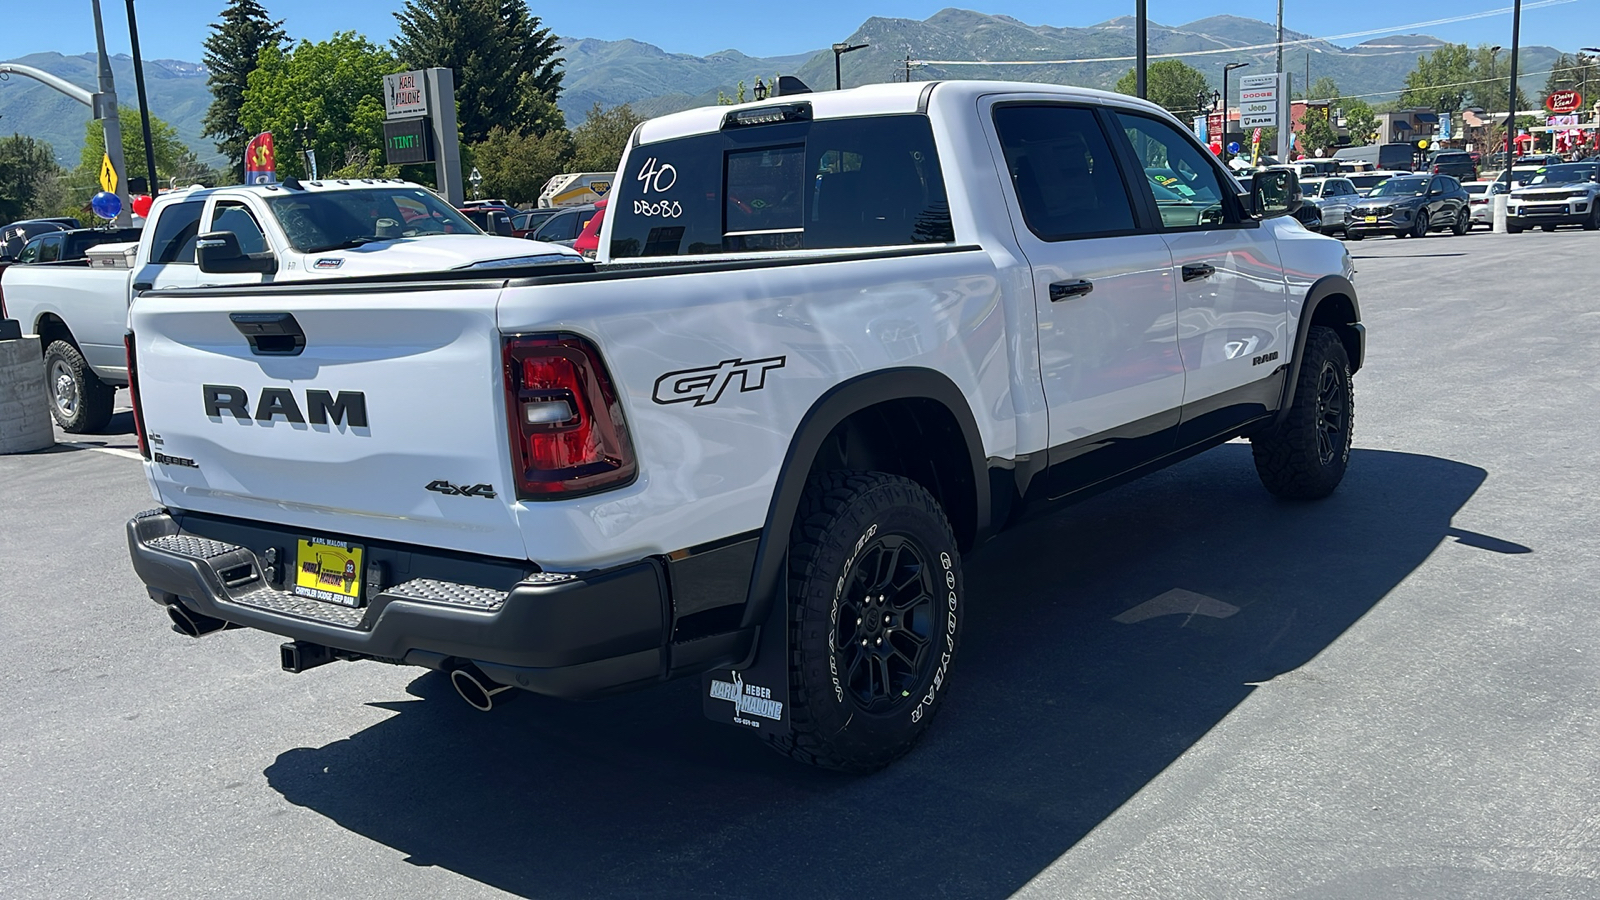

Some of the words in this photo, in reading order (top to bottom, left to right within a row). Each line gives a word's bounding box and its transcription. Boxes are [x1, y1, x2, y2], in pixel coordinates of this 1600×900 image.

[399, 76, 415, 89] KARL
[395, 90, 420, 107] MALONE
[1552, 92, 1575, 104] Dairy
[1248, 104, 1268, 112] Jeep
[393, 135, 413, 149] TINT
[637, 157, 677, 194] 40
[1252, 351, 1278, 366] RAM
[203, 384, 368, 428] RAM
[154, 452, 199, 469] REBEL
[312, 537, 326, 545] KARL
[326, 540, 347, 548] MALONE
[346, 563, 354, 573] 32
[295, 587, 317, 597] CHRYSLER
[317, 590, 333, 601] DODGE
[333, 595, 344, 604] JEEP
[343, 597, 354, 605] RAM
[910, 552, 957, 723] GOODYEAR
[710, 680, 736, 699] KARL
[745, 684, 771, 699] HEBER
[741, 694, 783, 720] MALONE
